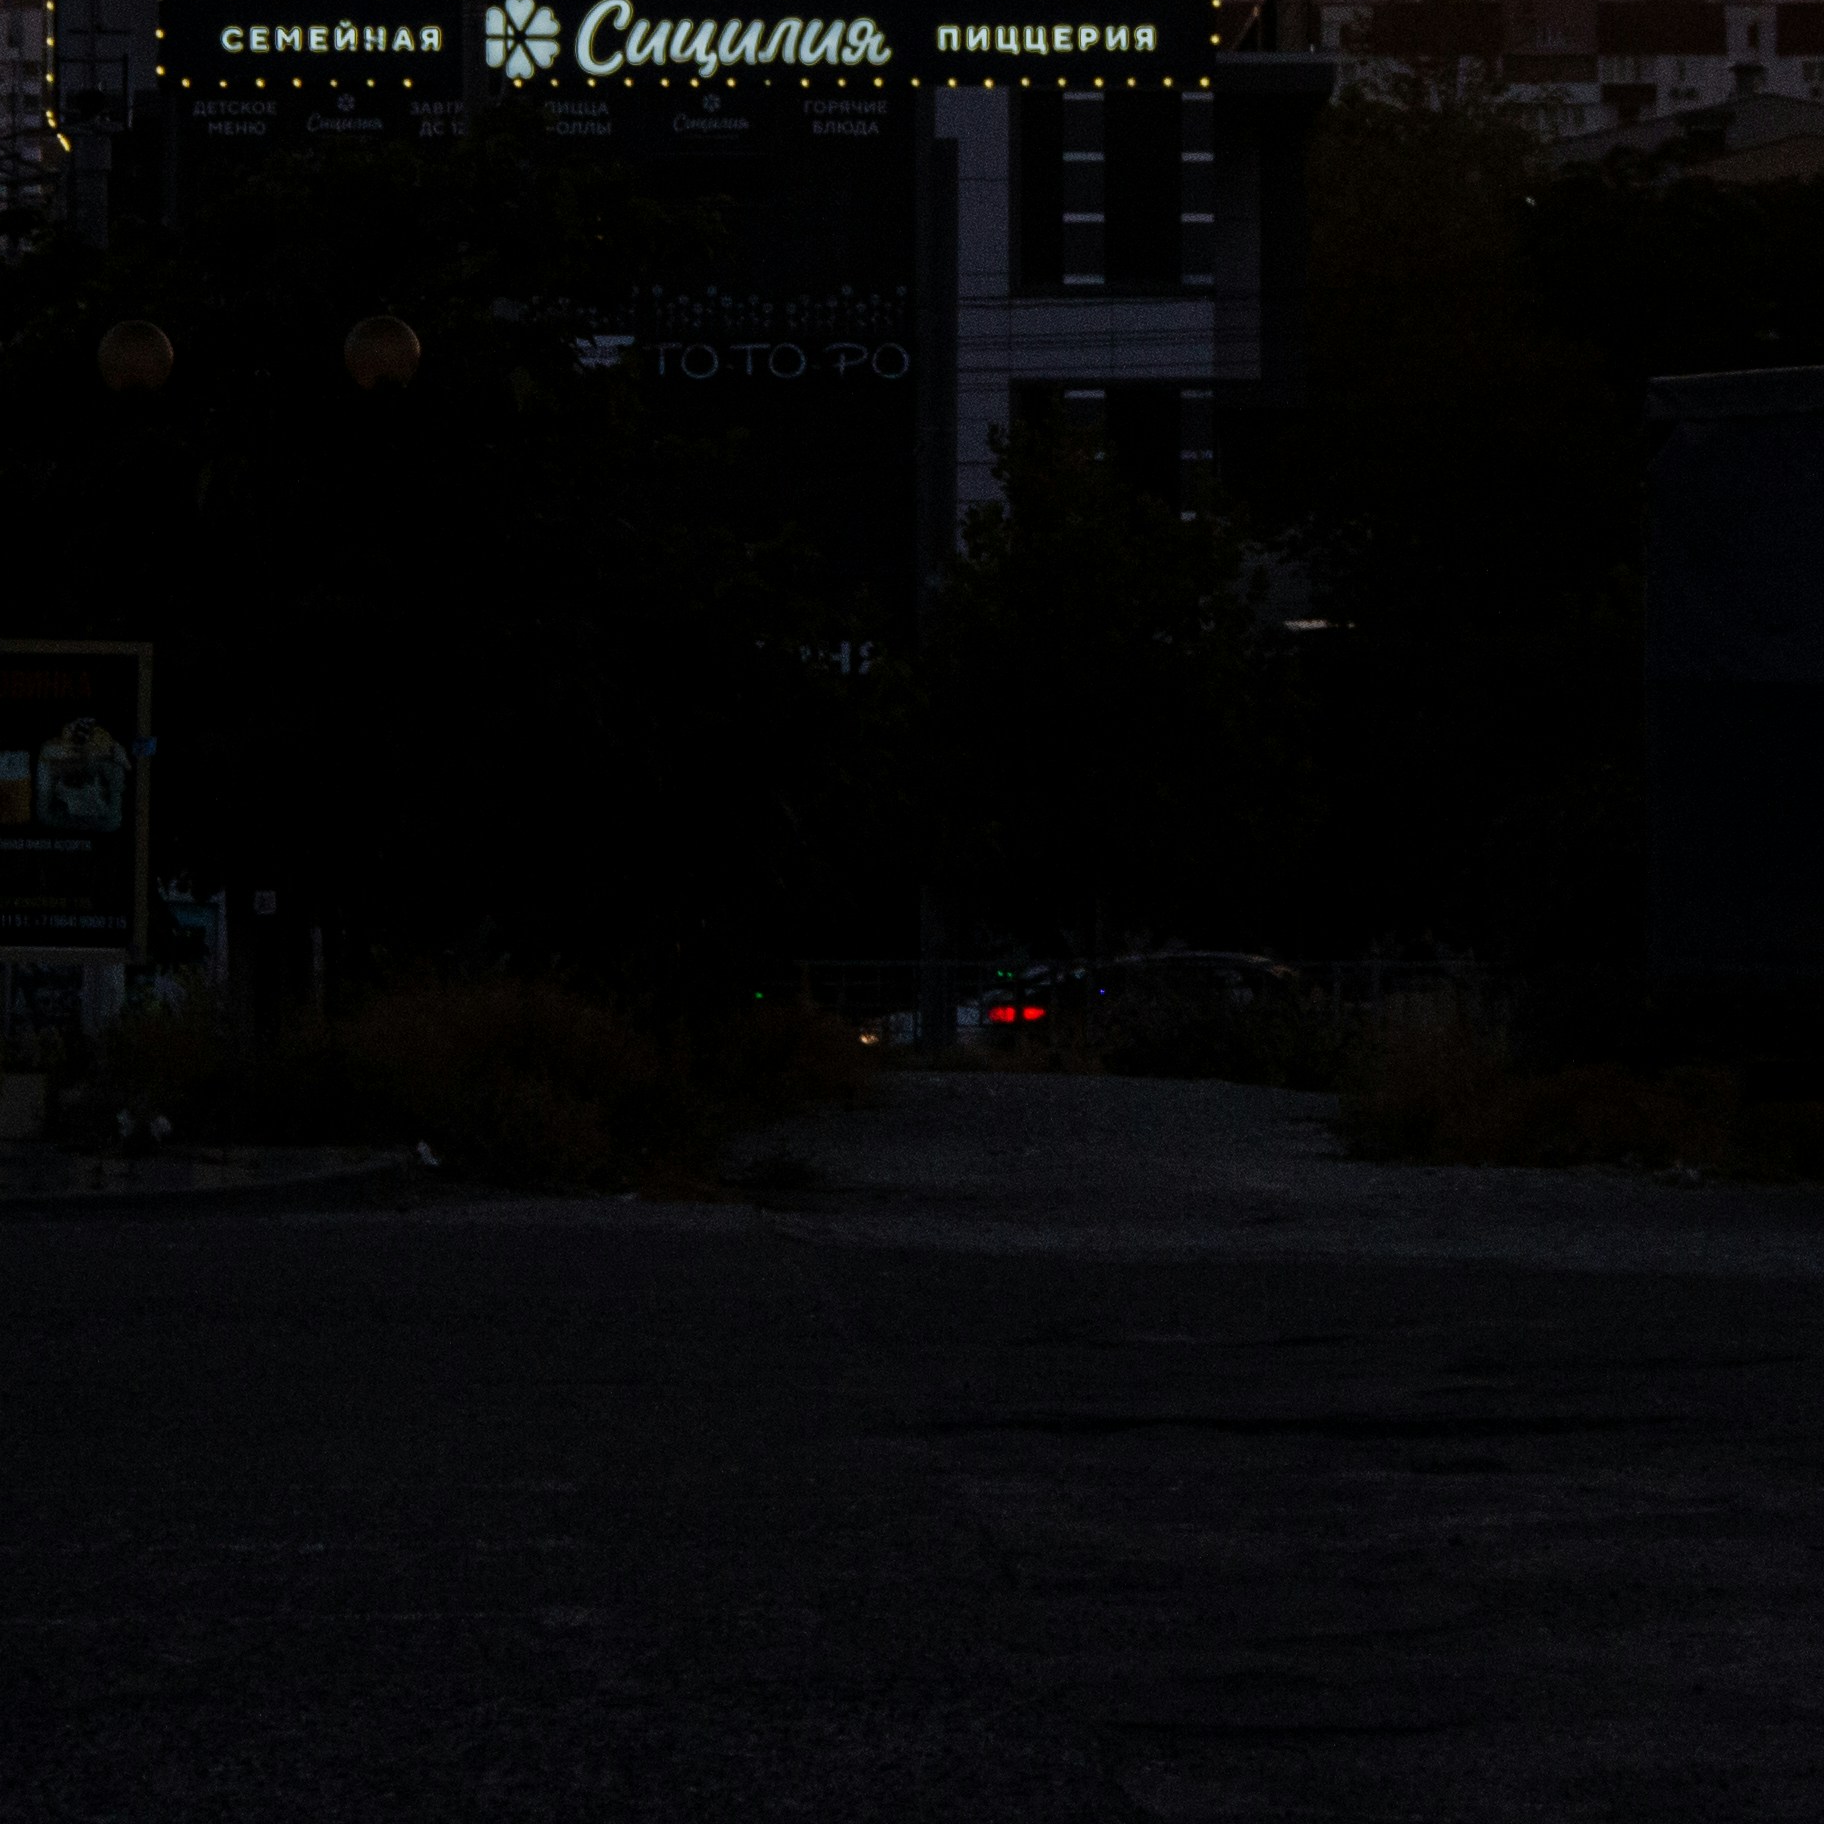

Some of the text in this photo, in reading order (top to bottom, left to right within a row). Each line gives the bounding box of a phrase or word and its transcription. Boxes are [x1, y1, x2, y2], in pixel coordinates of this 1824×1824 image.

[220, 19, 443, 53] СЕМЕЙНАЯ
[937, 24, 1157, 56] ПИЦЦЕРИЯ
[192, 101, 277, 117] ДЕТСКОЕ
[409, 101, 465, 116] ЗАВТР
[803, 99, 889, 116] ГОРЯЧИЕ
[208, 120, 267, 136] МЕНЮ
[306, 112, 384, 133] Сицилия
[672, 112, 750, 133] Сицилия
[811, 120, 881, 137] БЛЮДА
